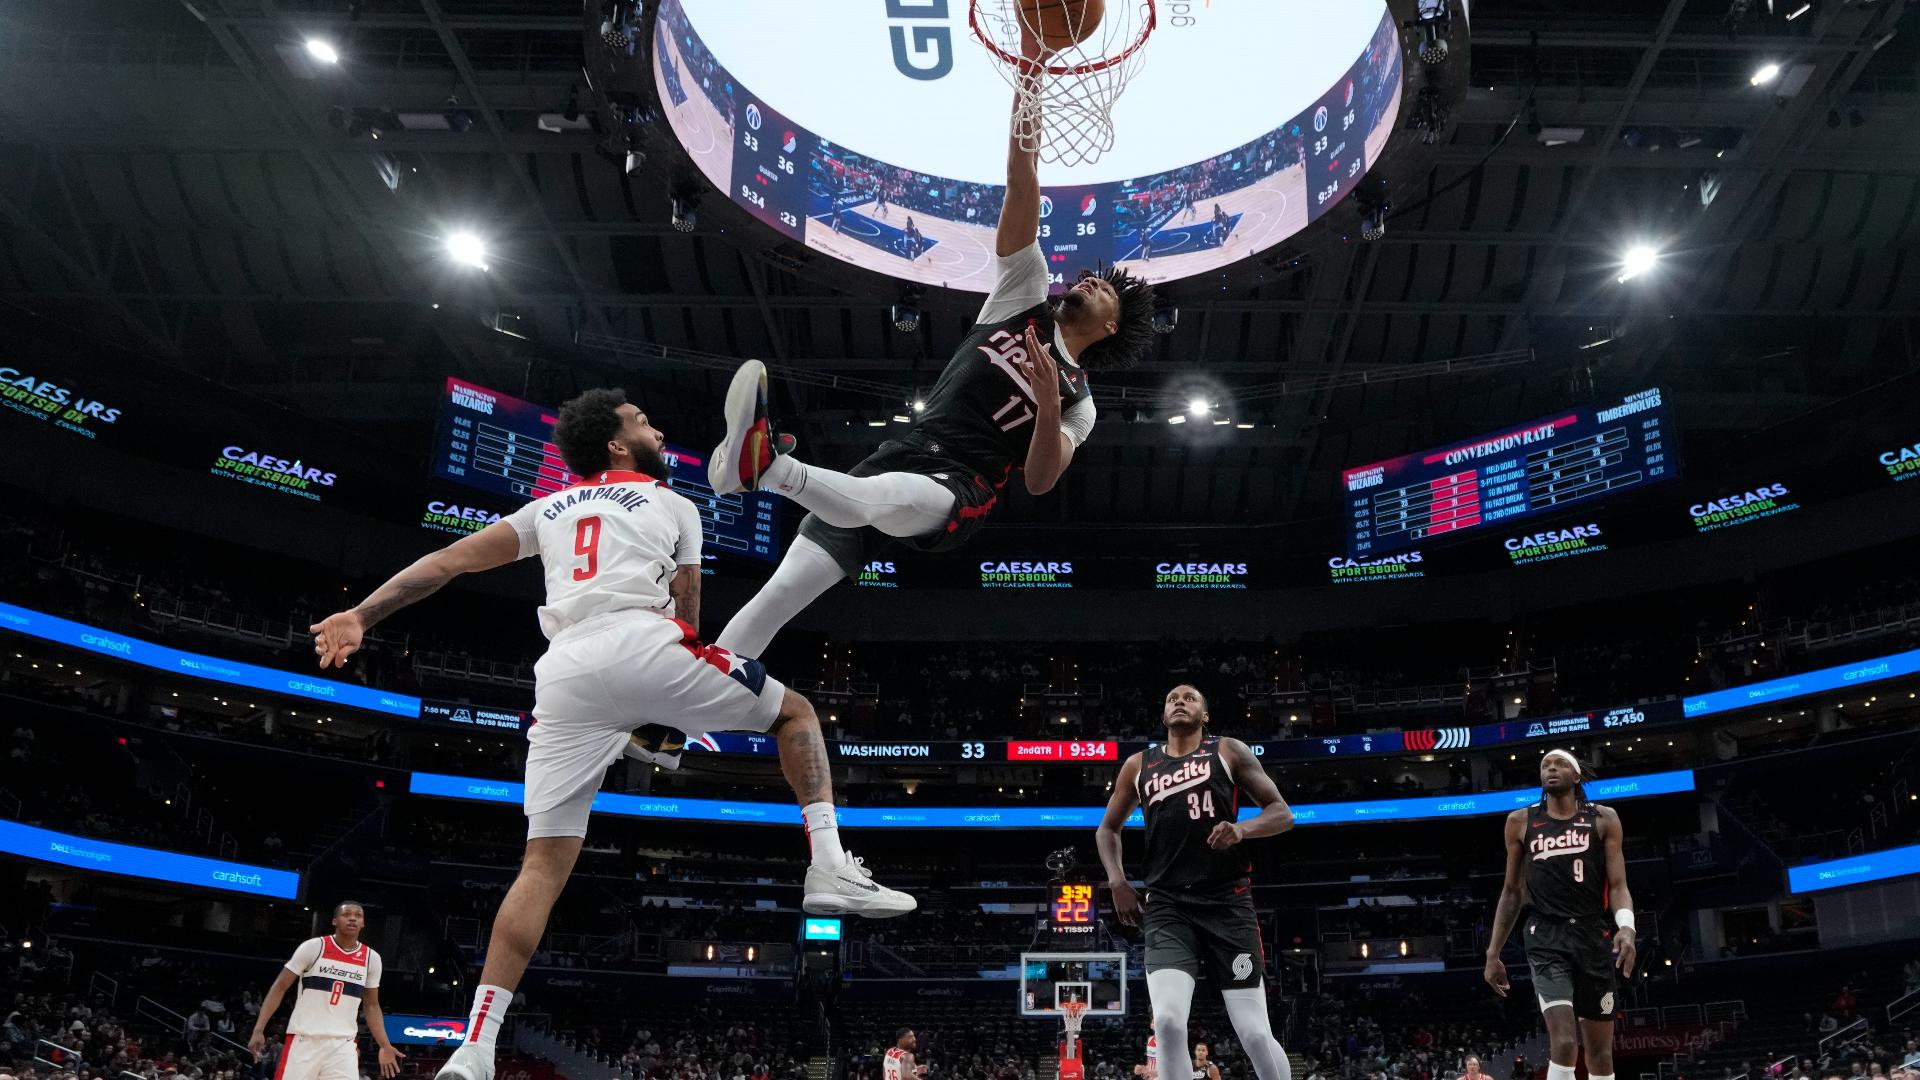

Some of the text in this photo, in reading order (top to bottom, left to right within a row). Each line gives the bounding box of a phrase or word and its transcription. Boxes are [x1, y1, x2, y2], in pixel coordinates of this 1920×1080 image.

[1343, 108, 1355, 131] 36
[744, 131, 759, 152] 33
[1314, 135, 1328, 156] 33
[778, 155, 794, 175] 36
[742, 184, 764, 209] 9:34
[1318, 179, 1338, 205] 9:34
[780, 211, 797, 228] :23
[1076, 222, 1096, 236] 36
[1054, 244, 1078, 252] QUARTER
[453, 384, 496, 403] WASHINGTON
[451, 391, 493, 415] WIZARDS
[1596, 394, 1661, 424] TIMBERWOLVES
[992, 395, 1034, 433] 17
[1445, 424, 1555, 466] CONVERSION RATE
[222, 446, 338, 487] CAESARS
[663, 452, 679, 468] TE
[215, 457, 311, 489] SPORTSBOOK
[1348, 466, 1384, 480] WASHINGTON
[1486, 463, 1500, 475] FIELD
[1348, 474, 1384, 492] WIZARDS
[1480, 477, 1493, 488] 3-PT
[1488, 489, 1496, 497] FG
[1503, 482, 1519, 493] PAINT
[543, 487, 650, 521] CHAMPAGNIE
[1485, 492, 1524, 509] FG FAST BREAK
[1689, 483, 1790, 517] CAESARS
[427, 501, 501, 523] CAESA
[1485, 503, 1527, 522] FG 2ND CHANCE
[1694, 499, 1777, 526] SPORTSBOOK
[423, 512, 486, 531] SPORTSB
[1722, 514, 1759, 528] CAESARS
[445, 526, 475, 536] CAESA
[1504, 523, 1602, 551] CAESARS
[573, 515, 602, 581] 9
[1509, 538, 1587, 559] SPORTSBOOK
[1535, 551, 1569, 562] CAESARS
[980, 562, 1072, 574] CAESARS
[1156, 563, 1247, 575] CAESARS
[1331, 563, 1407, 577] SPORTSBOOK
[981, 573, 1056, 582] SPORTSBOOK
[1156, 574, 1231, 583] SPORTSBOOK
[1353, 574, 1387, 582] CAESARS
[81, 633, 132, 655] carahsoft
[1843, 663, 1890, 681] carahsoft
[288, 679, 336, 697] carahsoft
[477, 711, 520, 722] FOUNDATION
[1548, 716, 1589, 728] FOUNDATION
[1603, 712, 1644, 728] $2,450
[497, 722, 520, 730] RAFFLE
[1569, 723, 1590, 732] RAFFLE
[753, 743, 758, 752] 1
[839, 743, 1106, 758] WASHINGTON 33 2ndQTR 9:34
[1329, 745, 1336, 754] 0
[1364, 743, 1371, 752] 6
[467, 785, 510, 797] carahsoft
[1144, 760, 1211, 805] ripcity
[1600, 782, 1639, 794] carahsoft
[639, 803, 679, 813] carahsoft
[1187, 790, 1215, 820] 34
[1438, 801, 1475, 811] carahsoft
[964, 814, 1001, 822] carahsoft
[1529, 829, 1590, 860] ripcity
[212, 869, 262, 887] carahsoft
[1573, 859, 1584, 883] 9
[1062, 885, 1092, 899] 9:34
[1056, 898, 1089, 922] 22
[319, 965, 364, 981] wizards
[329, 981, 344, 1005] 8
